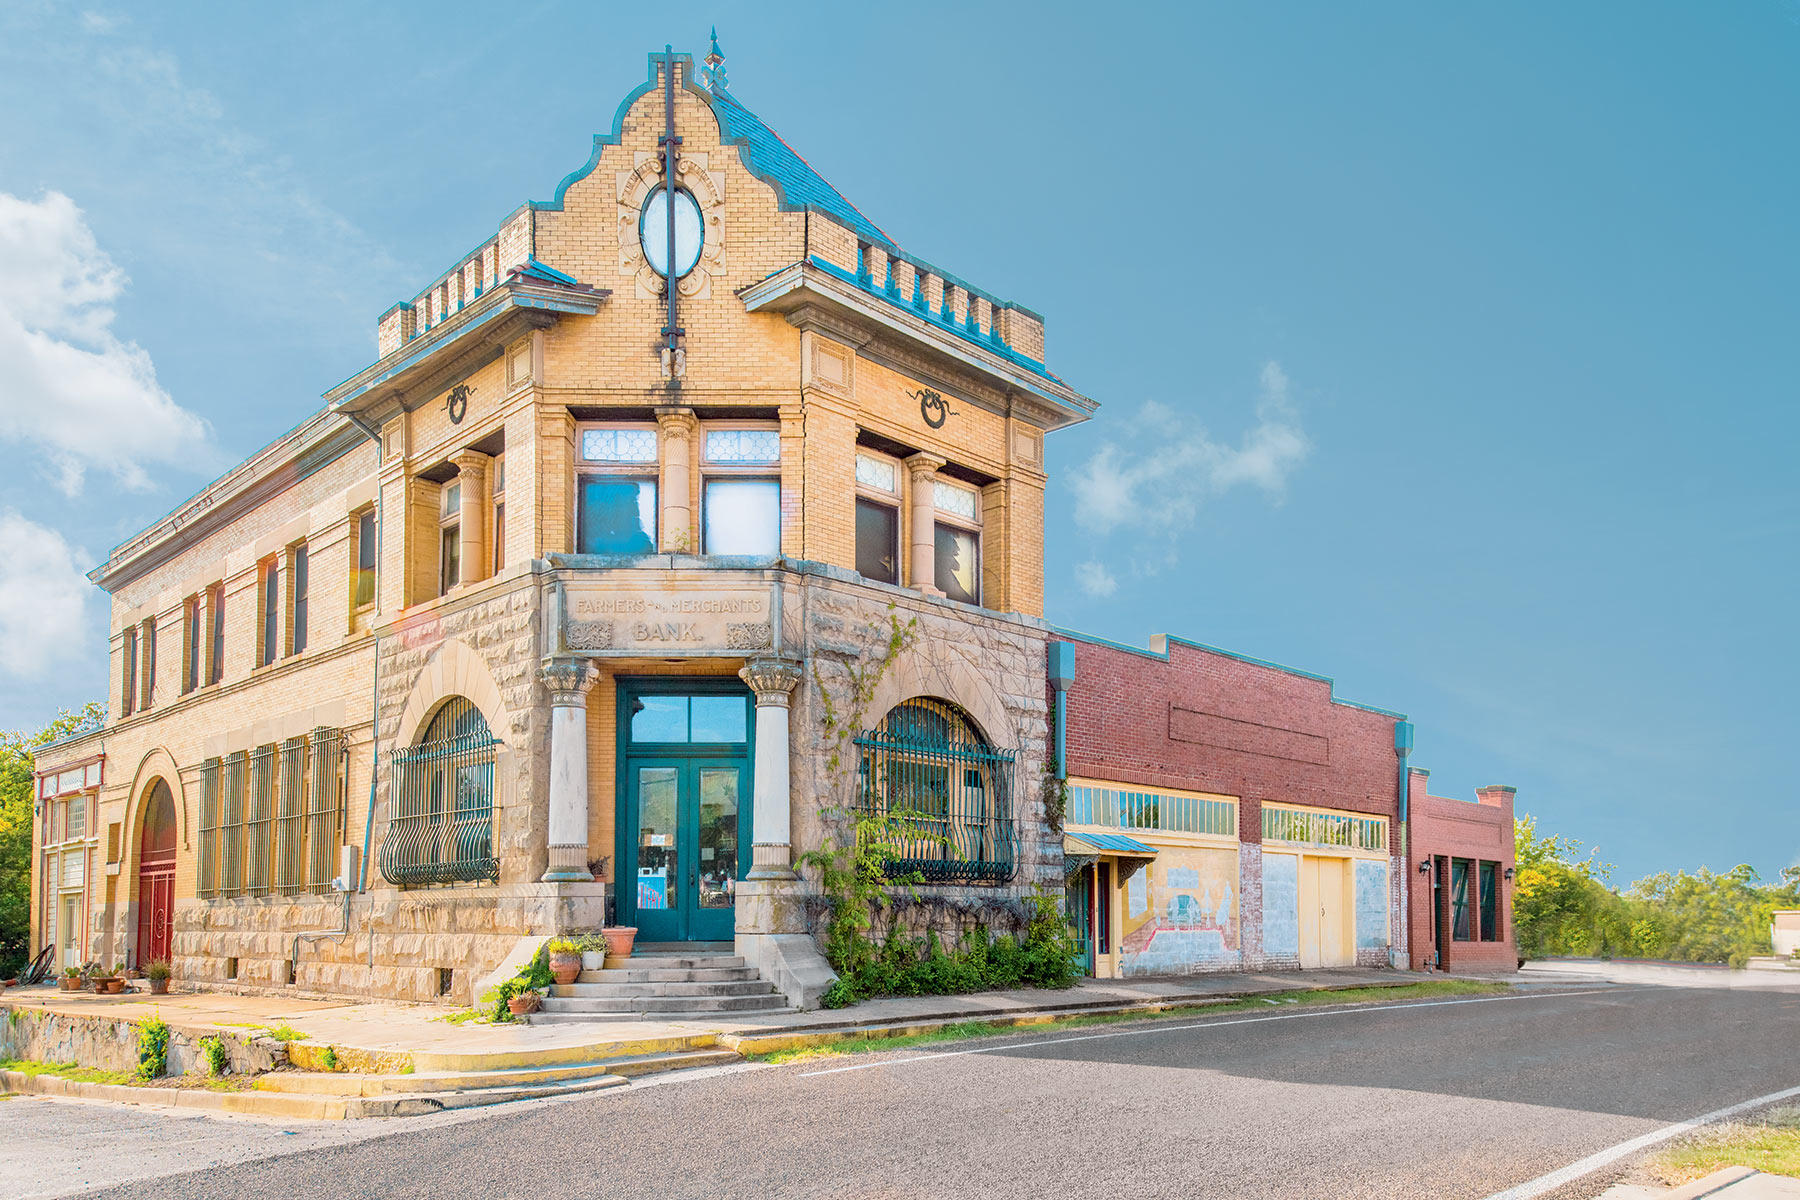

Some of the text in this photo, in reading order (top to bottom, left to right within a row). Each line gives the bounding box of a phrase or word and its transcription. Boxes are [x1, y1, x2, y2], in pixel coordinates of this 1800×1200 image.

[575, 599, 645, 614] FARMERS
[669, 599, 761, 613] MERCHANTS
[632, 622, 704, 641] BANK.
